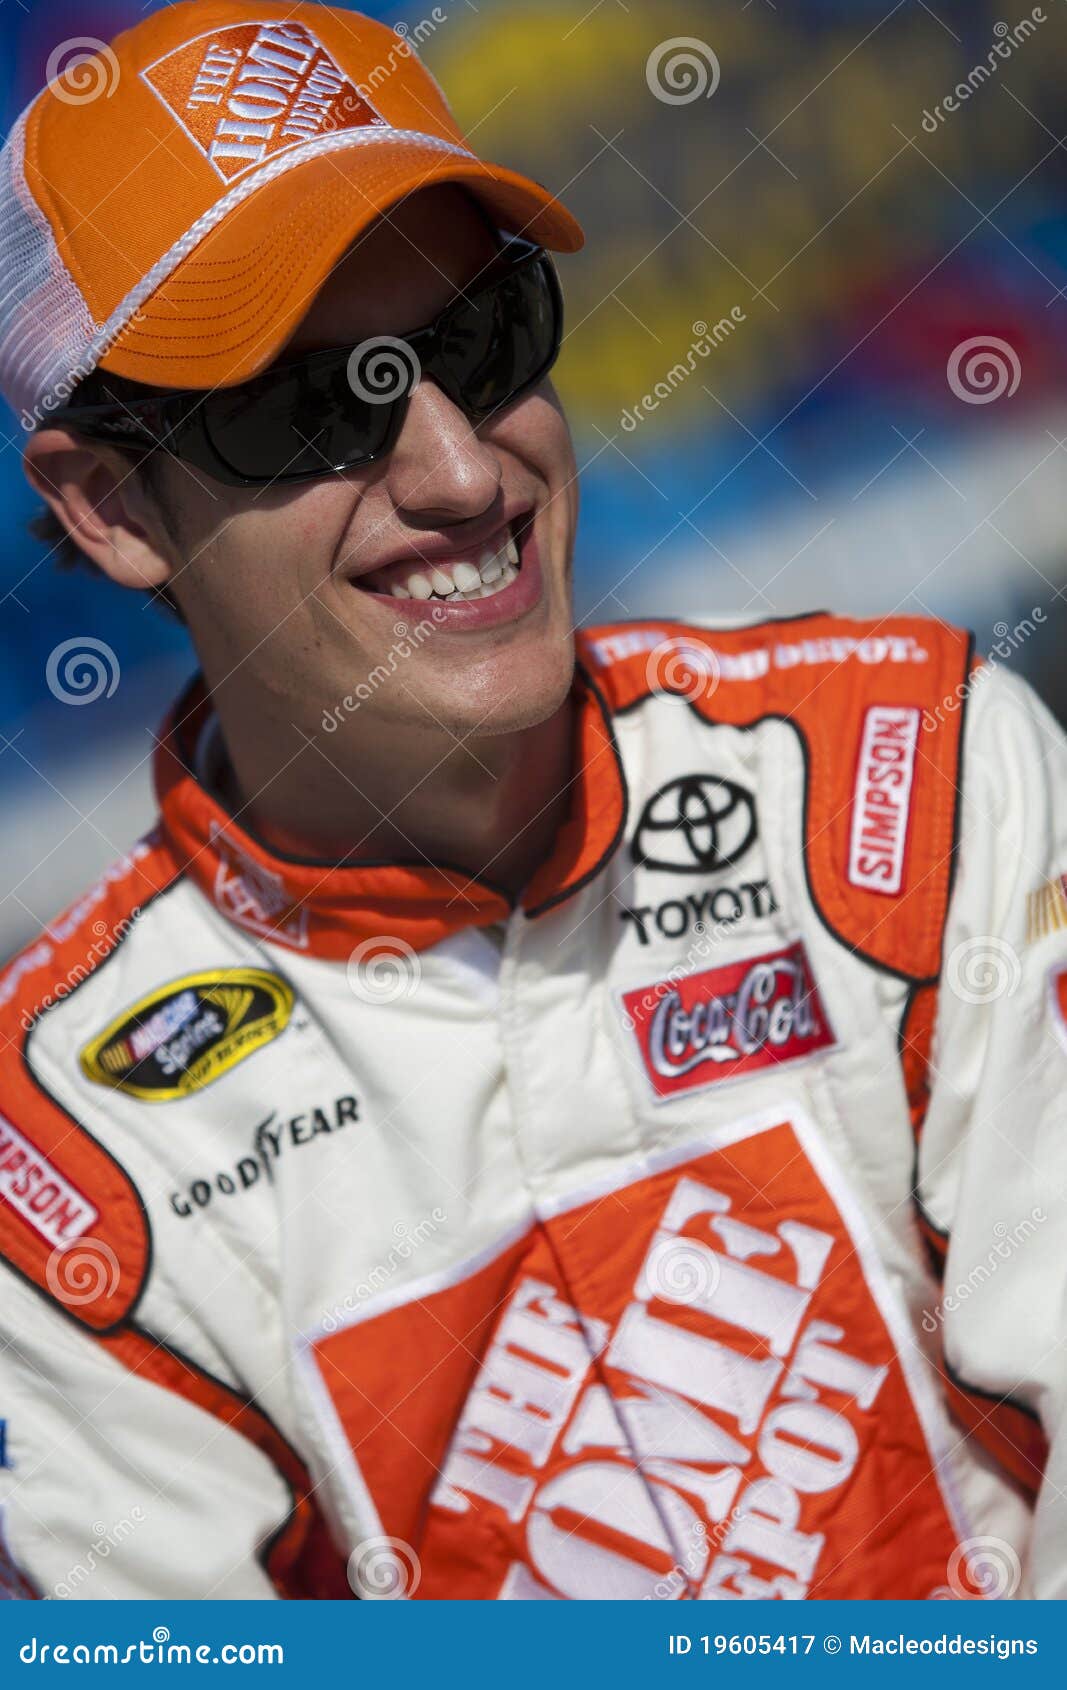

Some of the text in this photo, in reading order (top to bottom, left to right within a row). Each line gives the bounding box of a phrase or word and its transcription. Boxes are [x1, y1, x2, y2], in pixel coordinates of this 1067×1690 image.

[186, 42, 242, 110] THE
[208, 27, 320, 162] HOME
[857, 720, 909, 882] SIMPSON
[168, 1095, 360, 1218] GOODYEAR
[430, 1276, 610, 1524] THE
[500, 1176, 836, 1600] OME
[702, 1321, 889, 1600] EPOT
